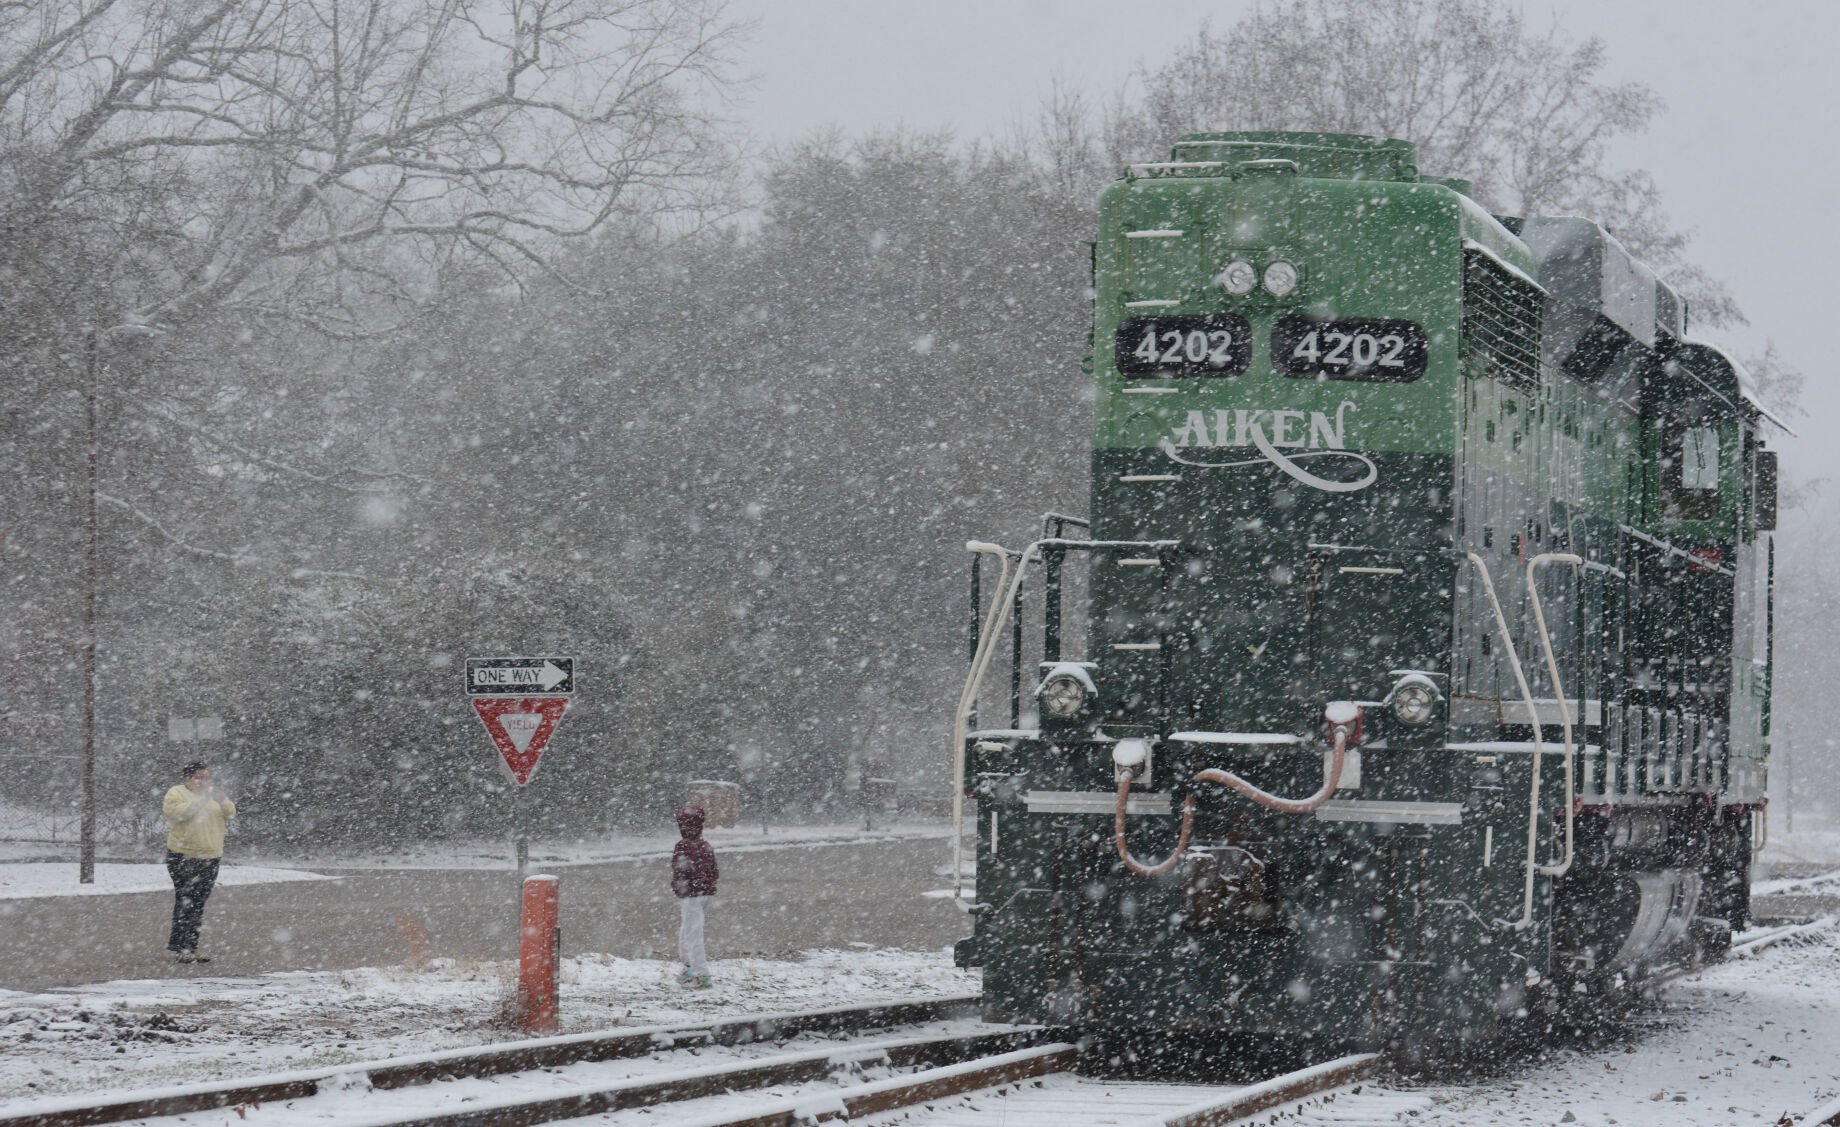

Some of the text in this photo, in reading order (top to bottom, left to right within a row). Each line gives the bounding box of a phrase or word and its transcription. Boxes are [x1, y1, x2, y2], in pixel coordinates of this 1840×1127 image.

[1135, 330, 1233, 364] 4202
[1293, 331, 1405, 366] 4202
[1160, 401, 1377, 492] AIKEN
[478, 669, 541, 683] ONE WAY
[507, 719, 535, 730] YIELD
